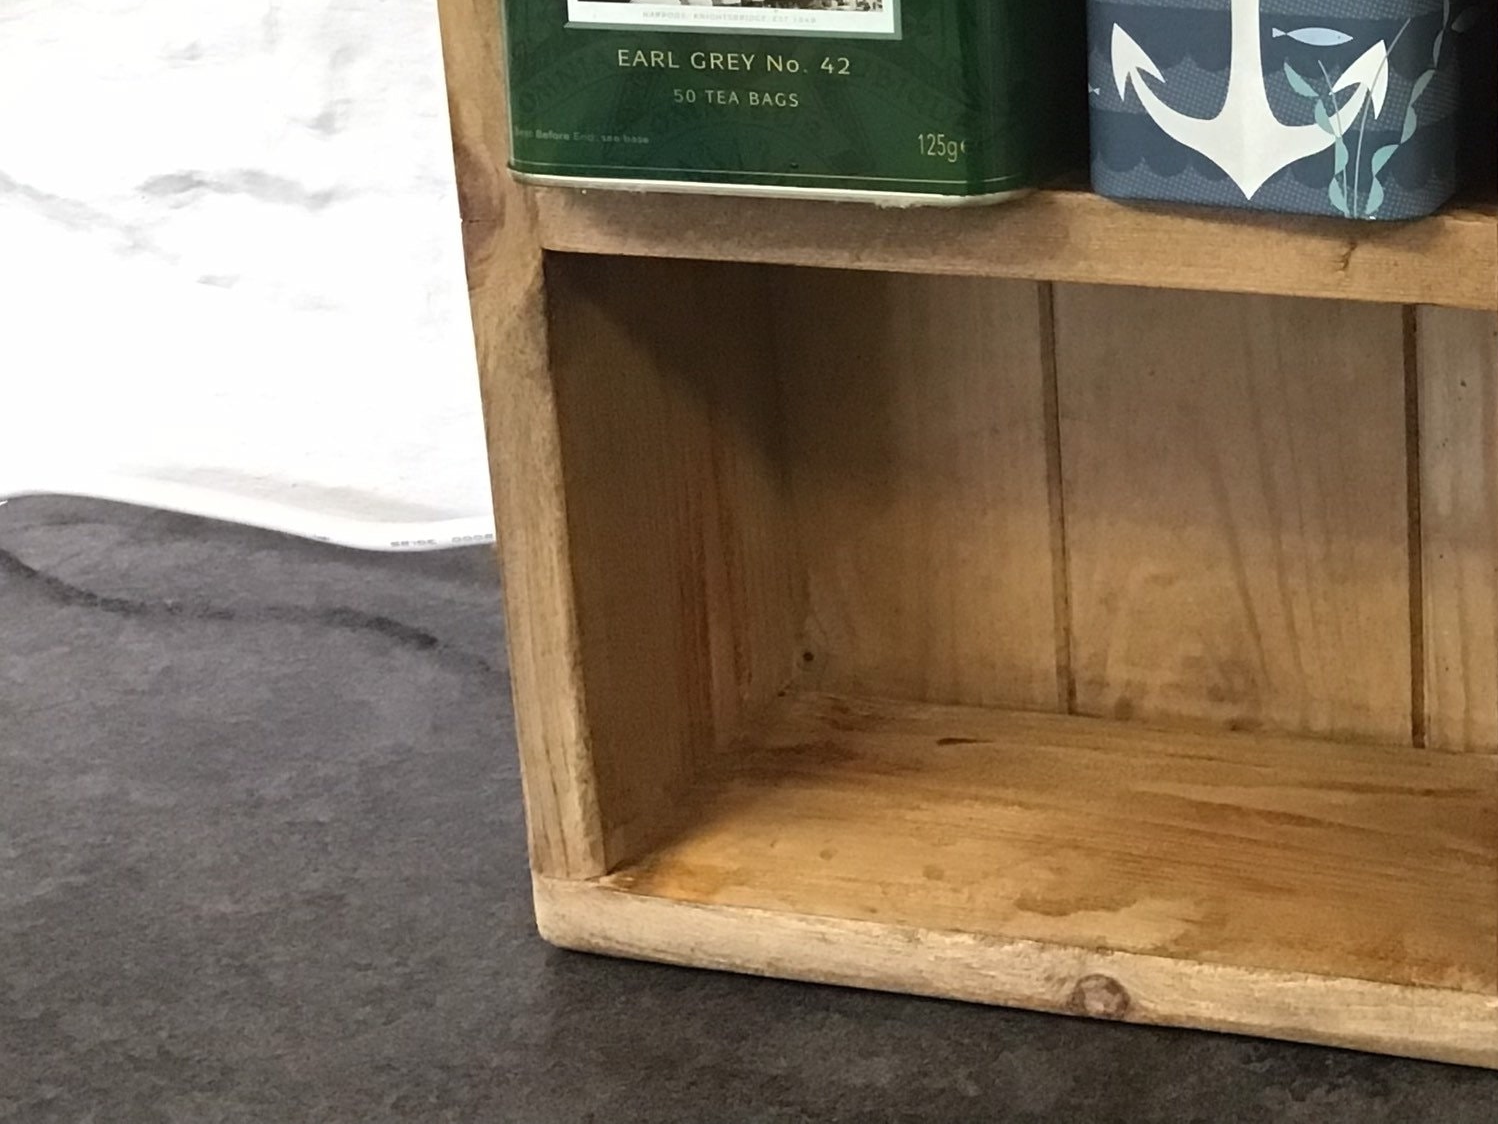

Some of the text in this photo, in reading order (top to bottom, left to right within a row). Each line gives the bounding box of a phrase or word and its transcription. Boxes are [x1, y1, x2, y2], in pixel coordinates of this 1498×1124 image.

[617, 49, 850, 75] EARL GREY No. 42
[673, 88, 799, 108] 50 TEA BAGS
